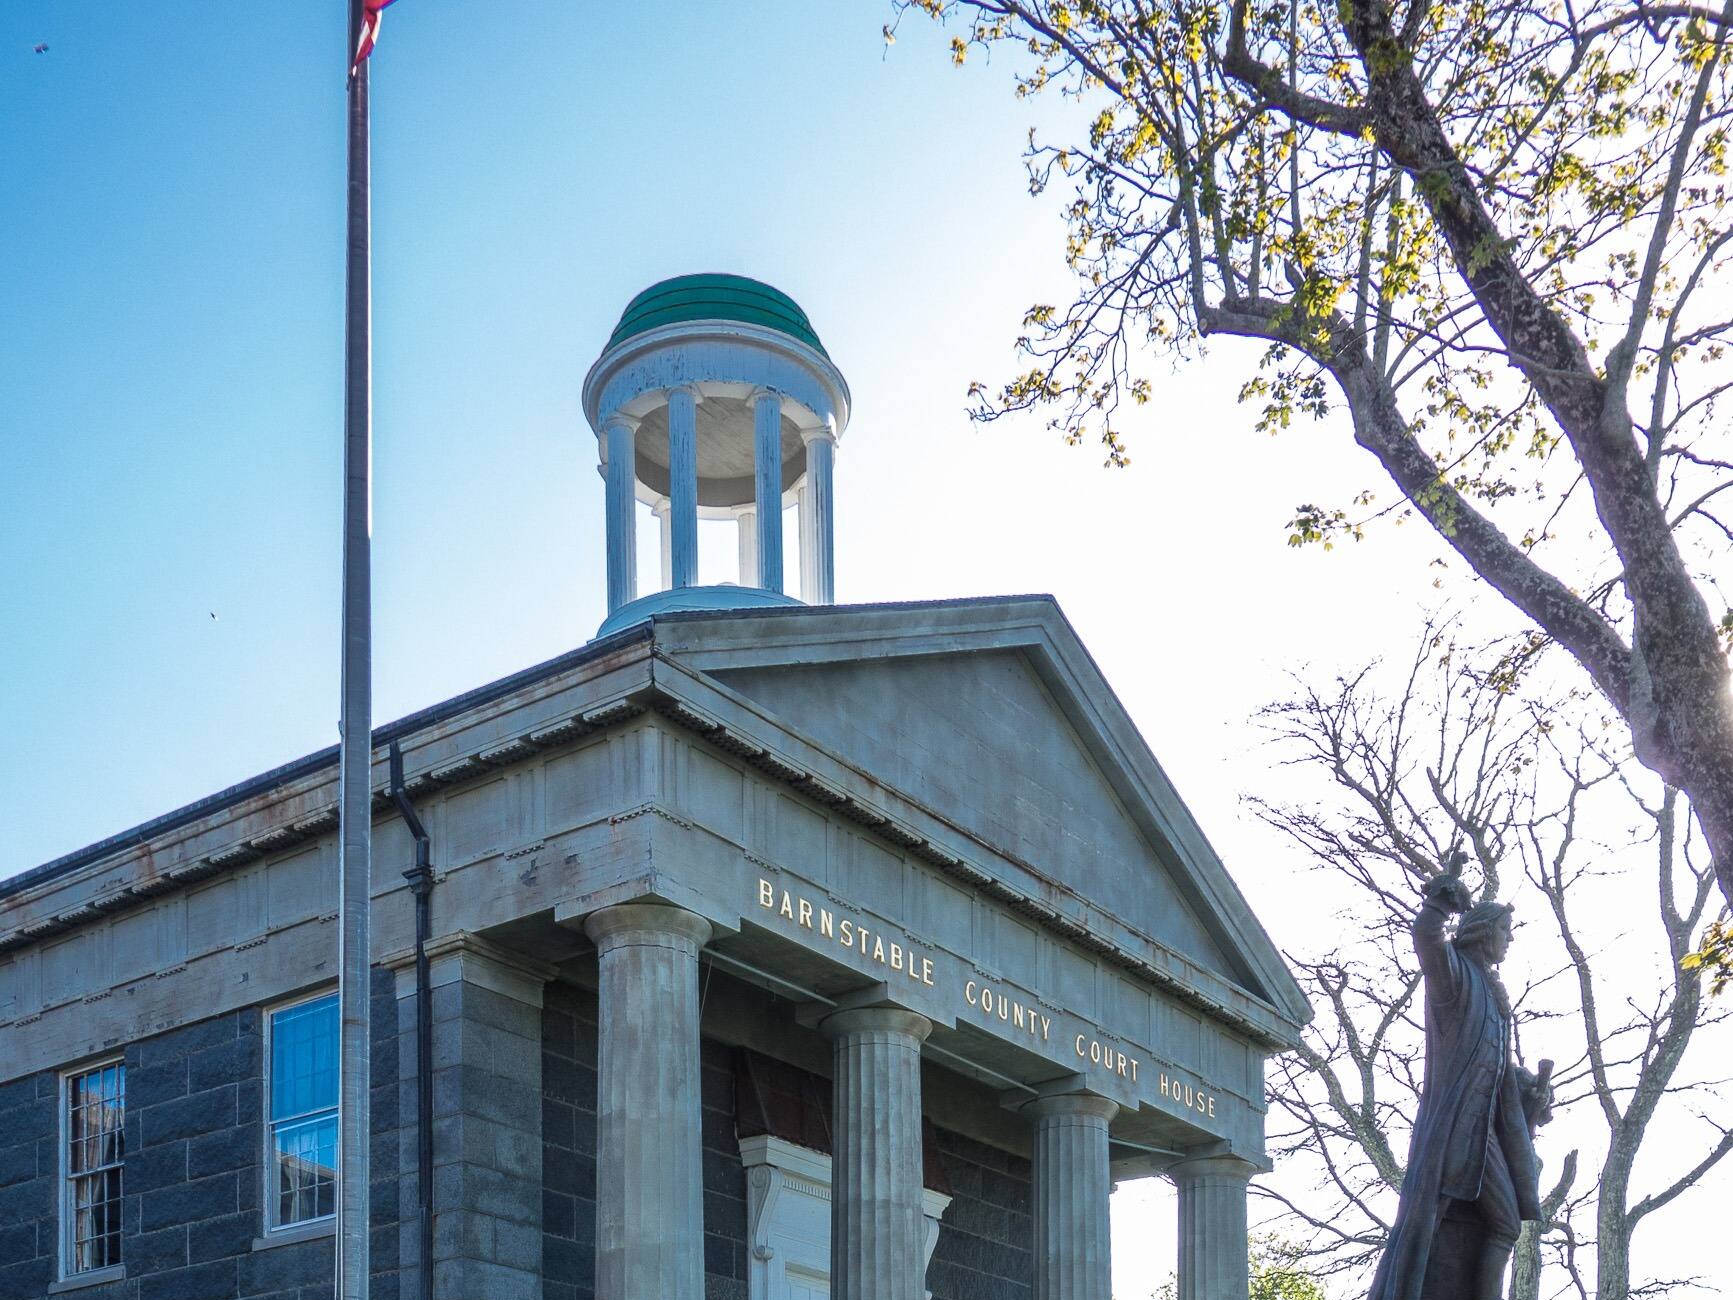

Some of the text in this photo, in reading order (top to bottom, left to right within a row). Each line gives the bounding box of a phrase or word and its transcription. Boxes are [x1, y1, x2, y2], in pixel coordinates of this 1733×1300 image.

[758, 877, 1216, 1119] BARNSTABLE COUNTY COURT HOUSE
